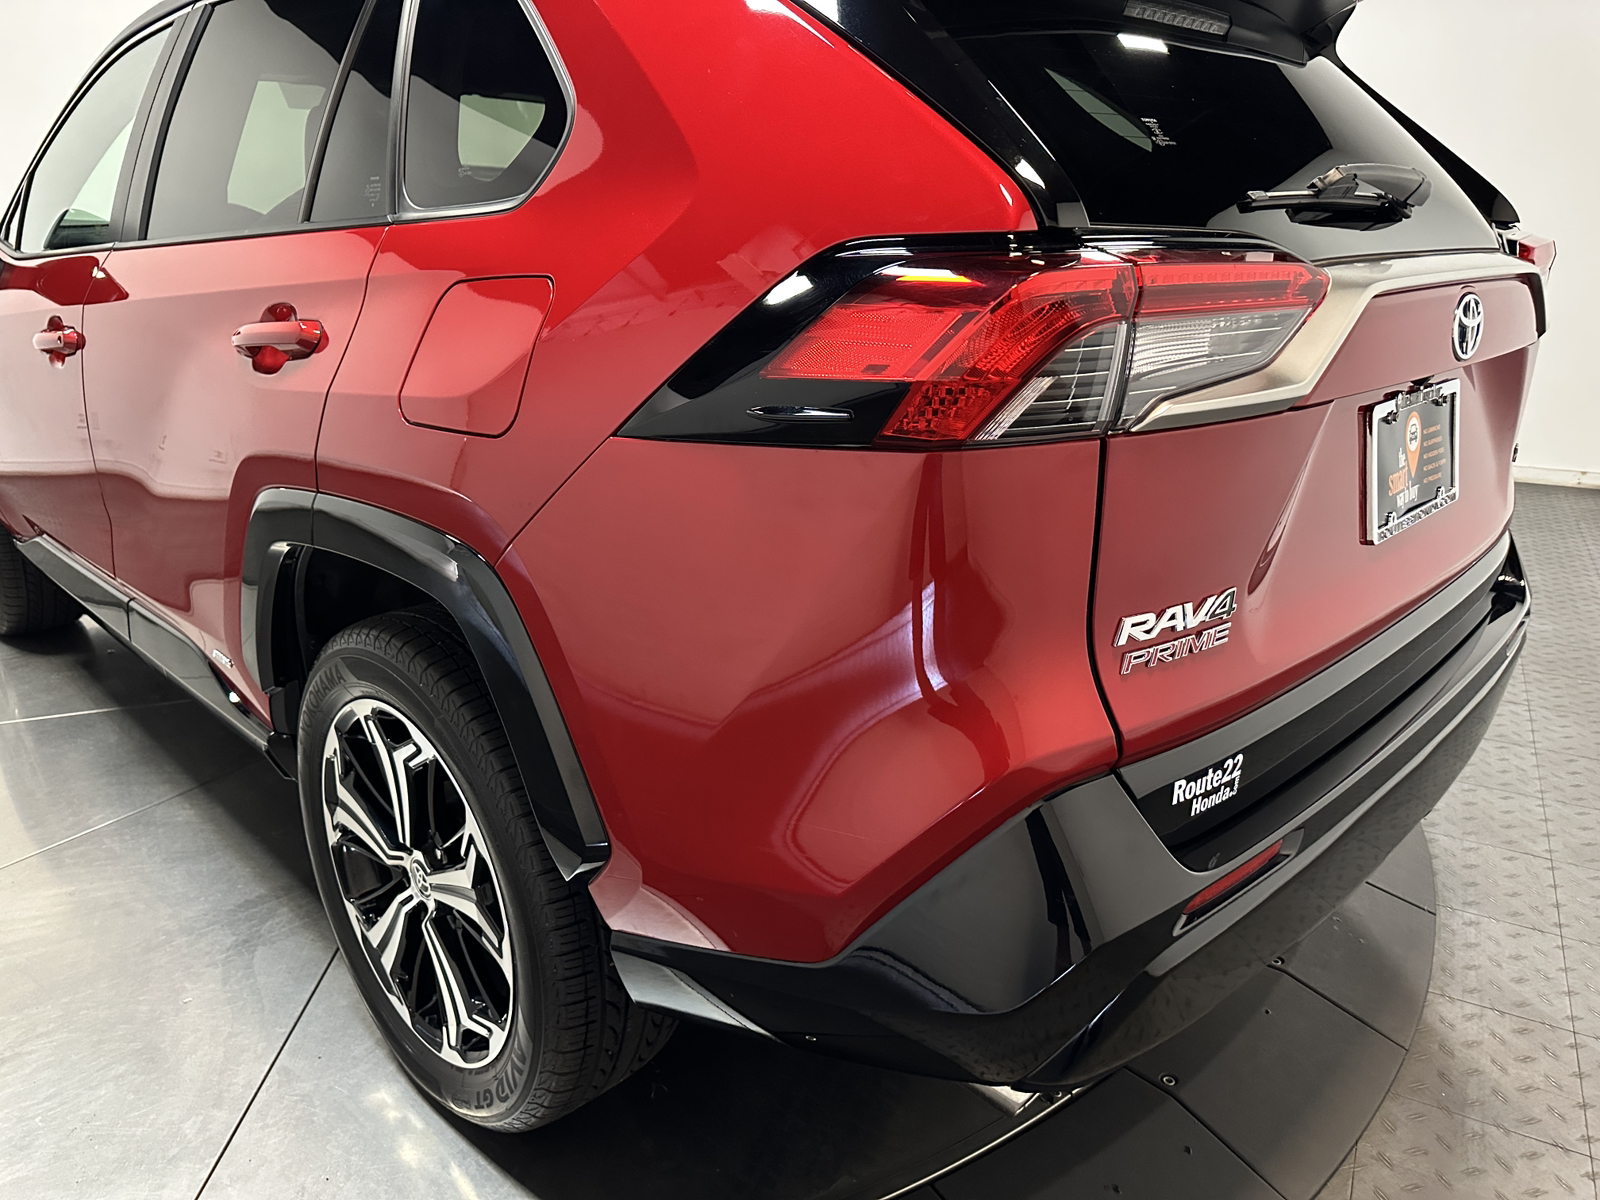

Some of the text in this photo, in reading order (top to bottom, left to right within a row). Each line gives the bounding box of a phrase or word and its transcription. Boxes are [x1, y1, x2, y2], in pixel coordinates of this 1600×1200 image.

[1113, 586, 1237, 647] RAV4
[1121, 622, 1231, 674] PRIME
[1172, 753, 1244, 806] Route22
[474, 1088, 494, 1109] GT
